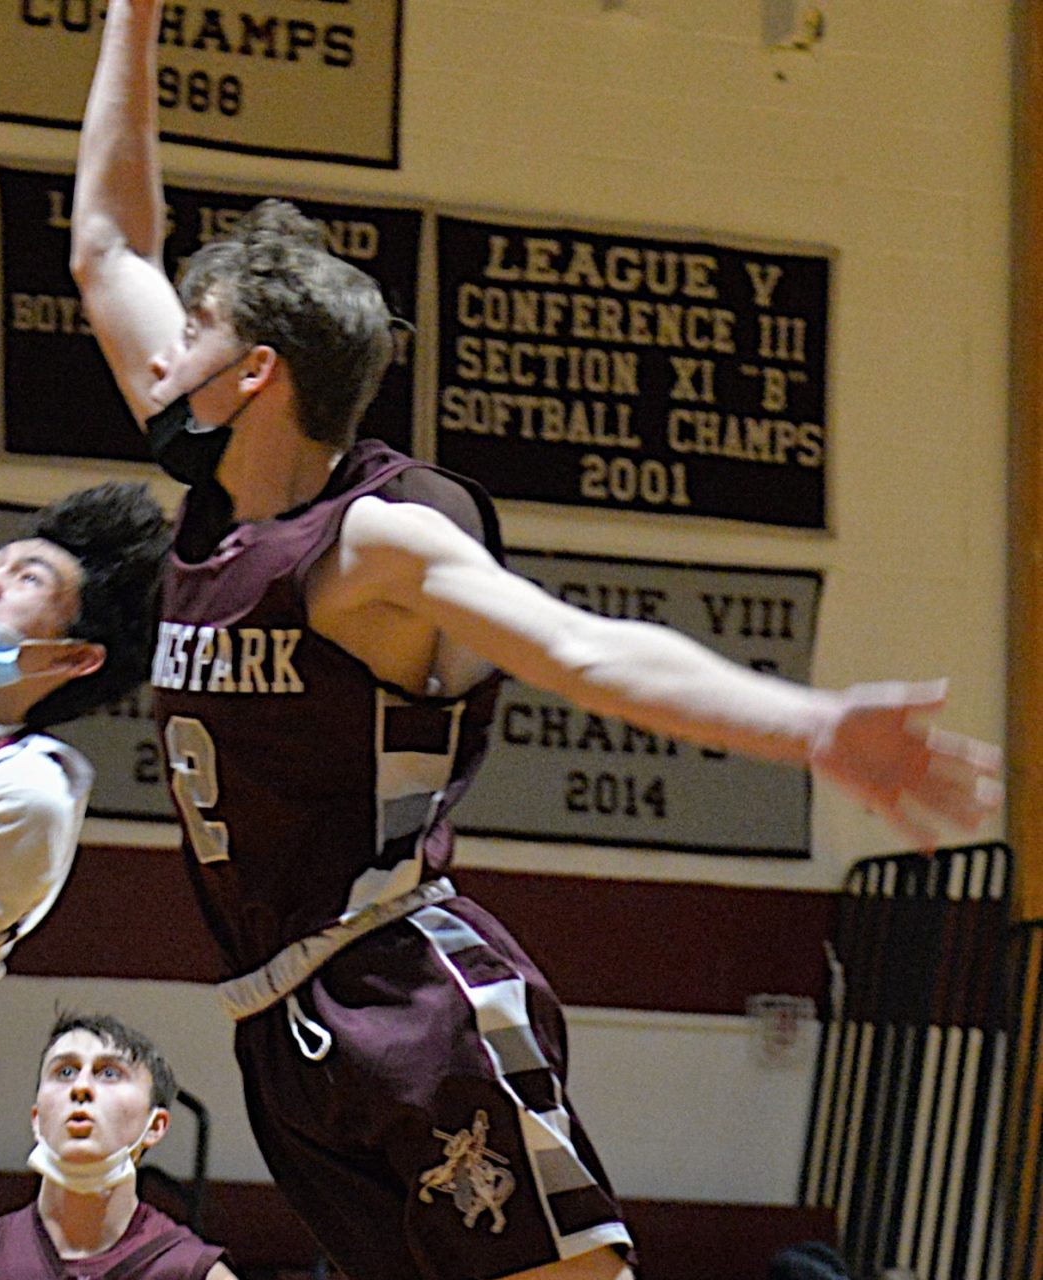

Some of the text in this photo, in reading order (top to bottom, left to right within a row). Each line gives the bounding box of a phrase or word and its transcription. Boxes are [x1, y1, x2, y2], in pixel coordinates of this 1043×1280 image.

[158, 66, 242, 116] 988
[485, 236, 783, 308] LEAGUE V
[458, 284, 736, 355] CONFERENCE
[759, 315, 807, 363] III
[458, 336, 640, 397] SECTION
[669, 356, 715, 403] XI
[441, 386, 824, 468] SOFTBALL CHAMPS
[580, 453, 691, 507] 2001
[701, 591, 796, 640] VIII
[188, 626, 305, 694] PARK
[565, 769, 667, 819] 2014
